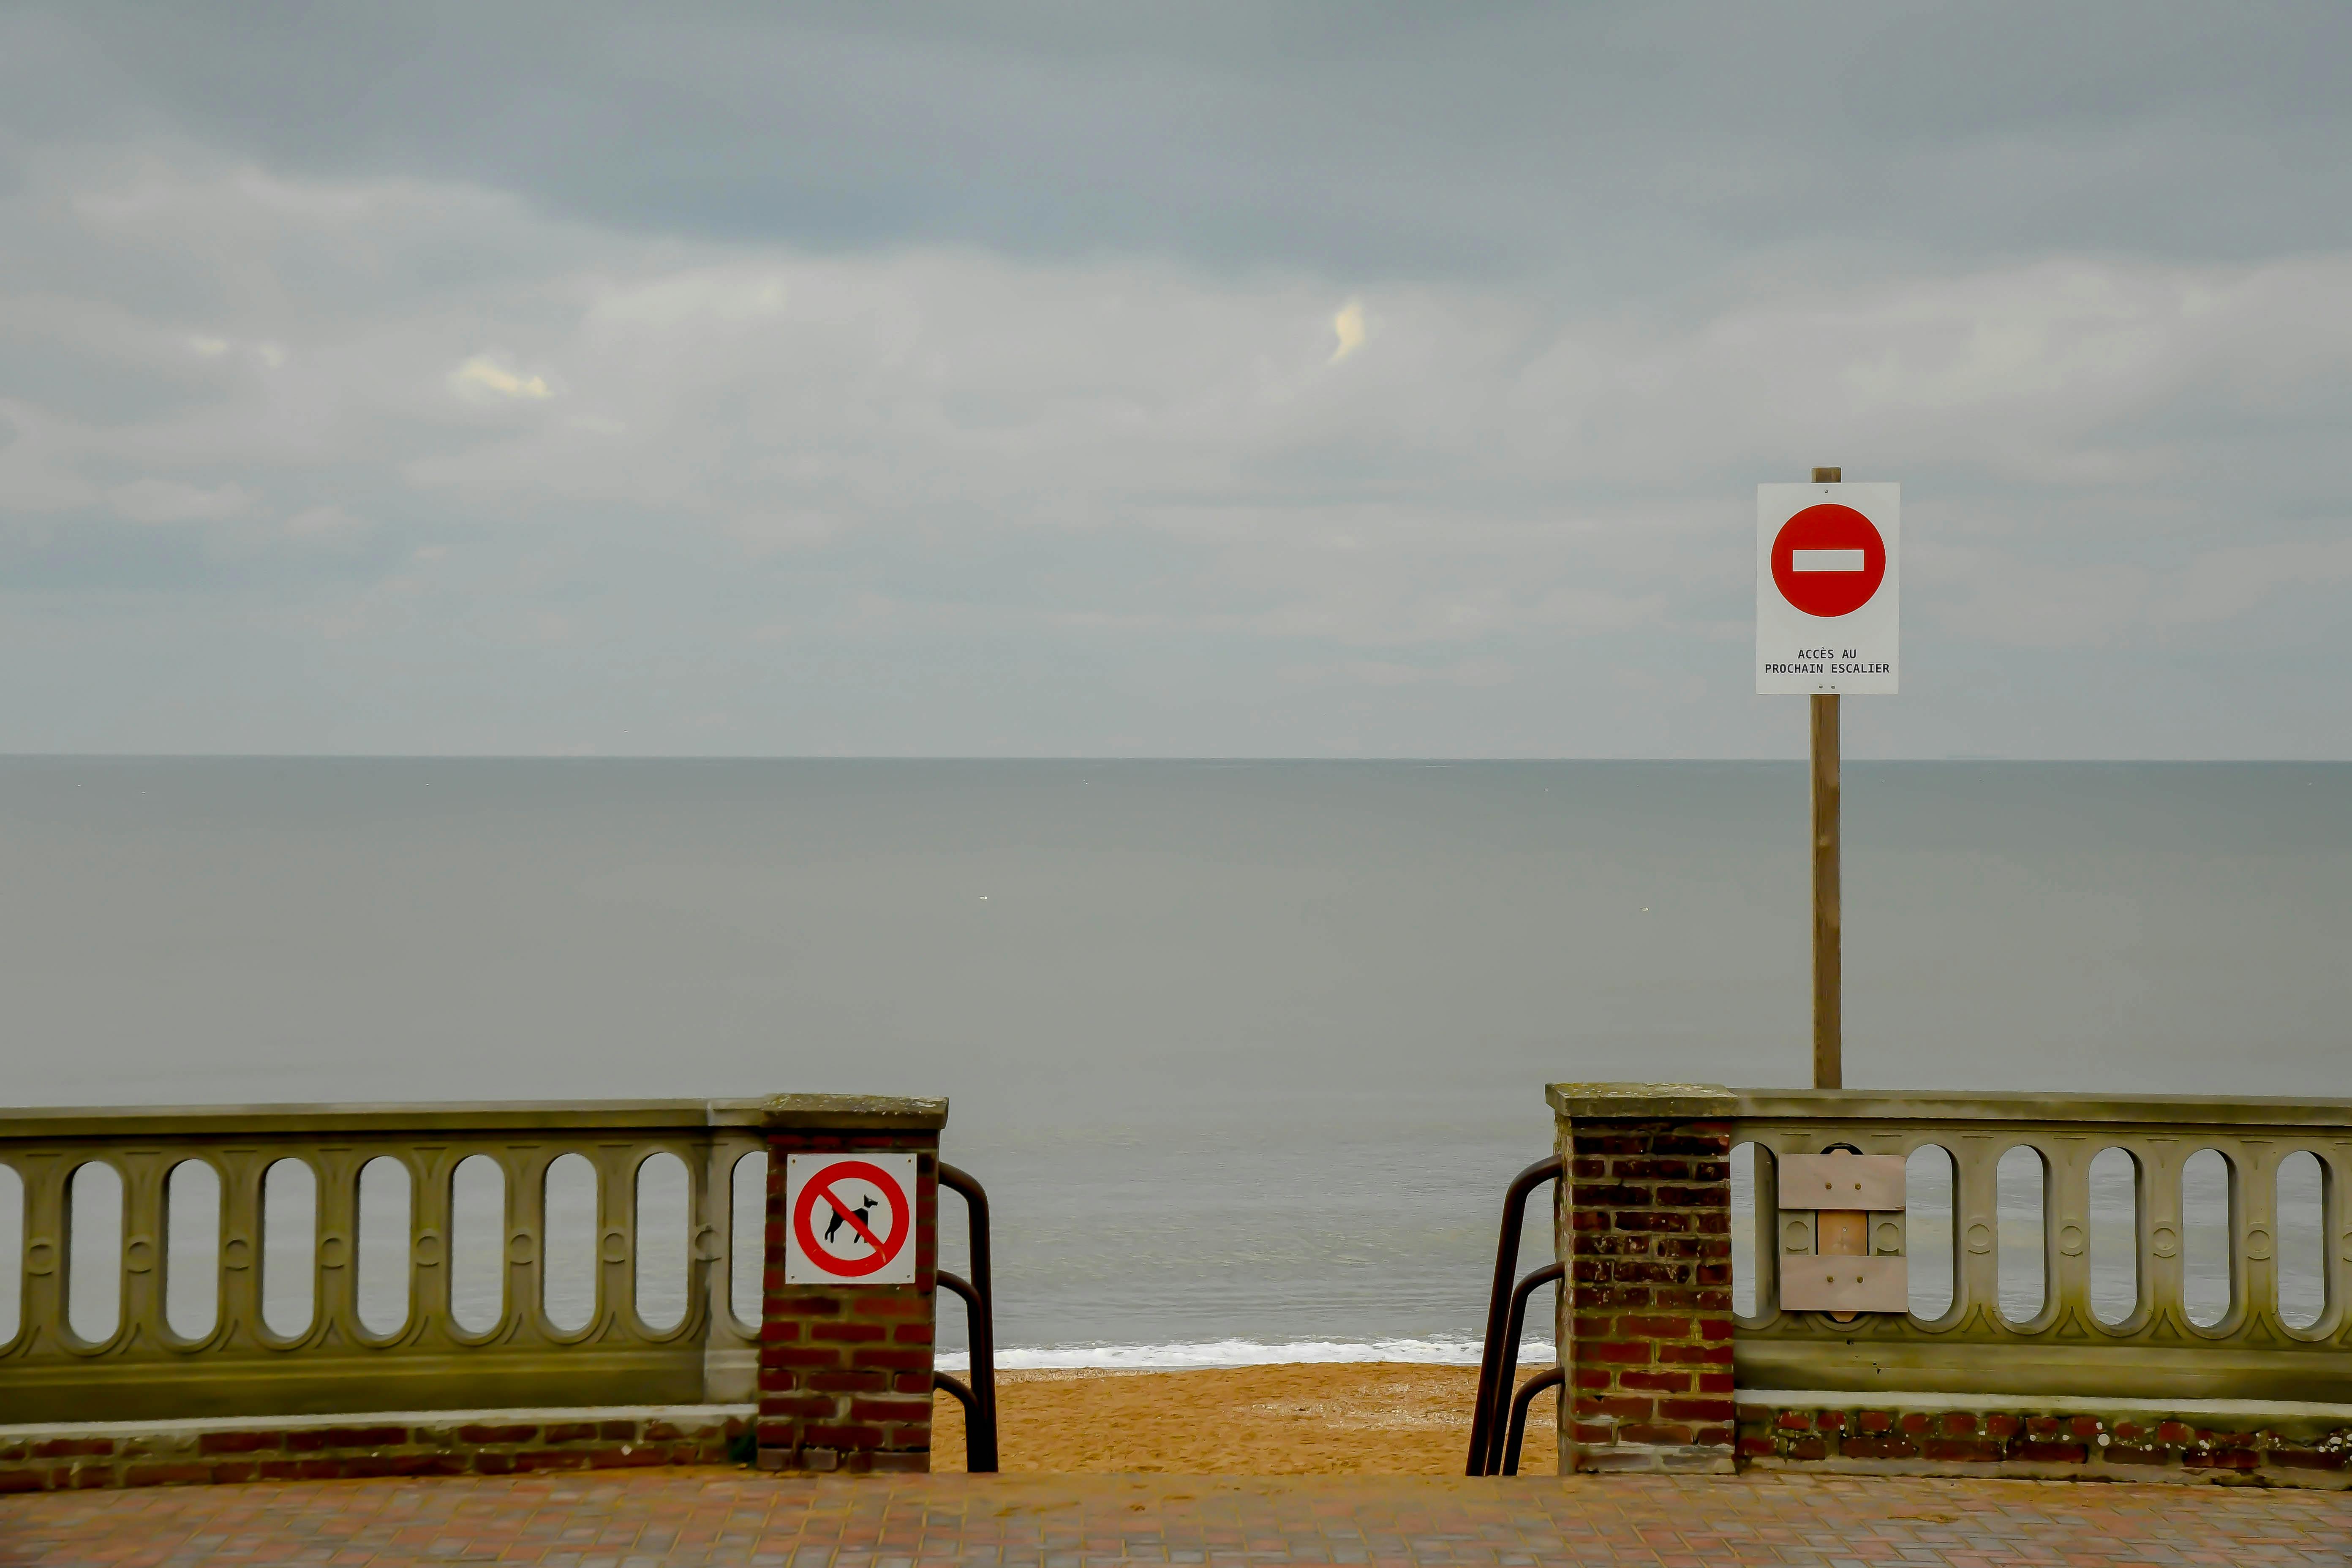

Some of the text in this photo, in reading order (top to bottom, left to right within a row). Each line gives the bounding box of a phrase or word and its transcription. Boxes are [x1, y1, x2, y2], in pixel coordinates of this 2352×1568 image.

[1797, 647, 1857, 659] ACCÈS AU
[1765, 664, 1890, 673] PROCHAIN ESCALIER
